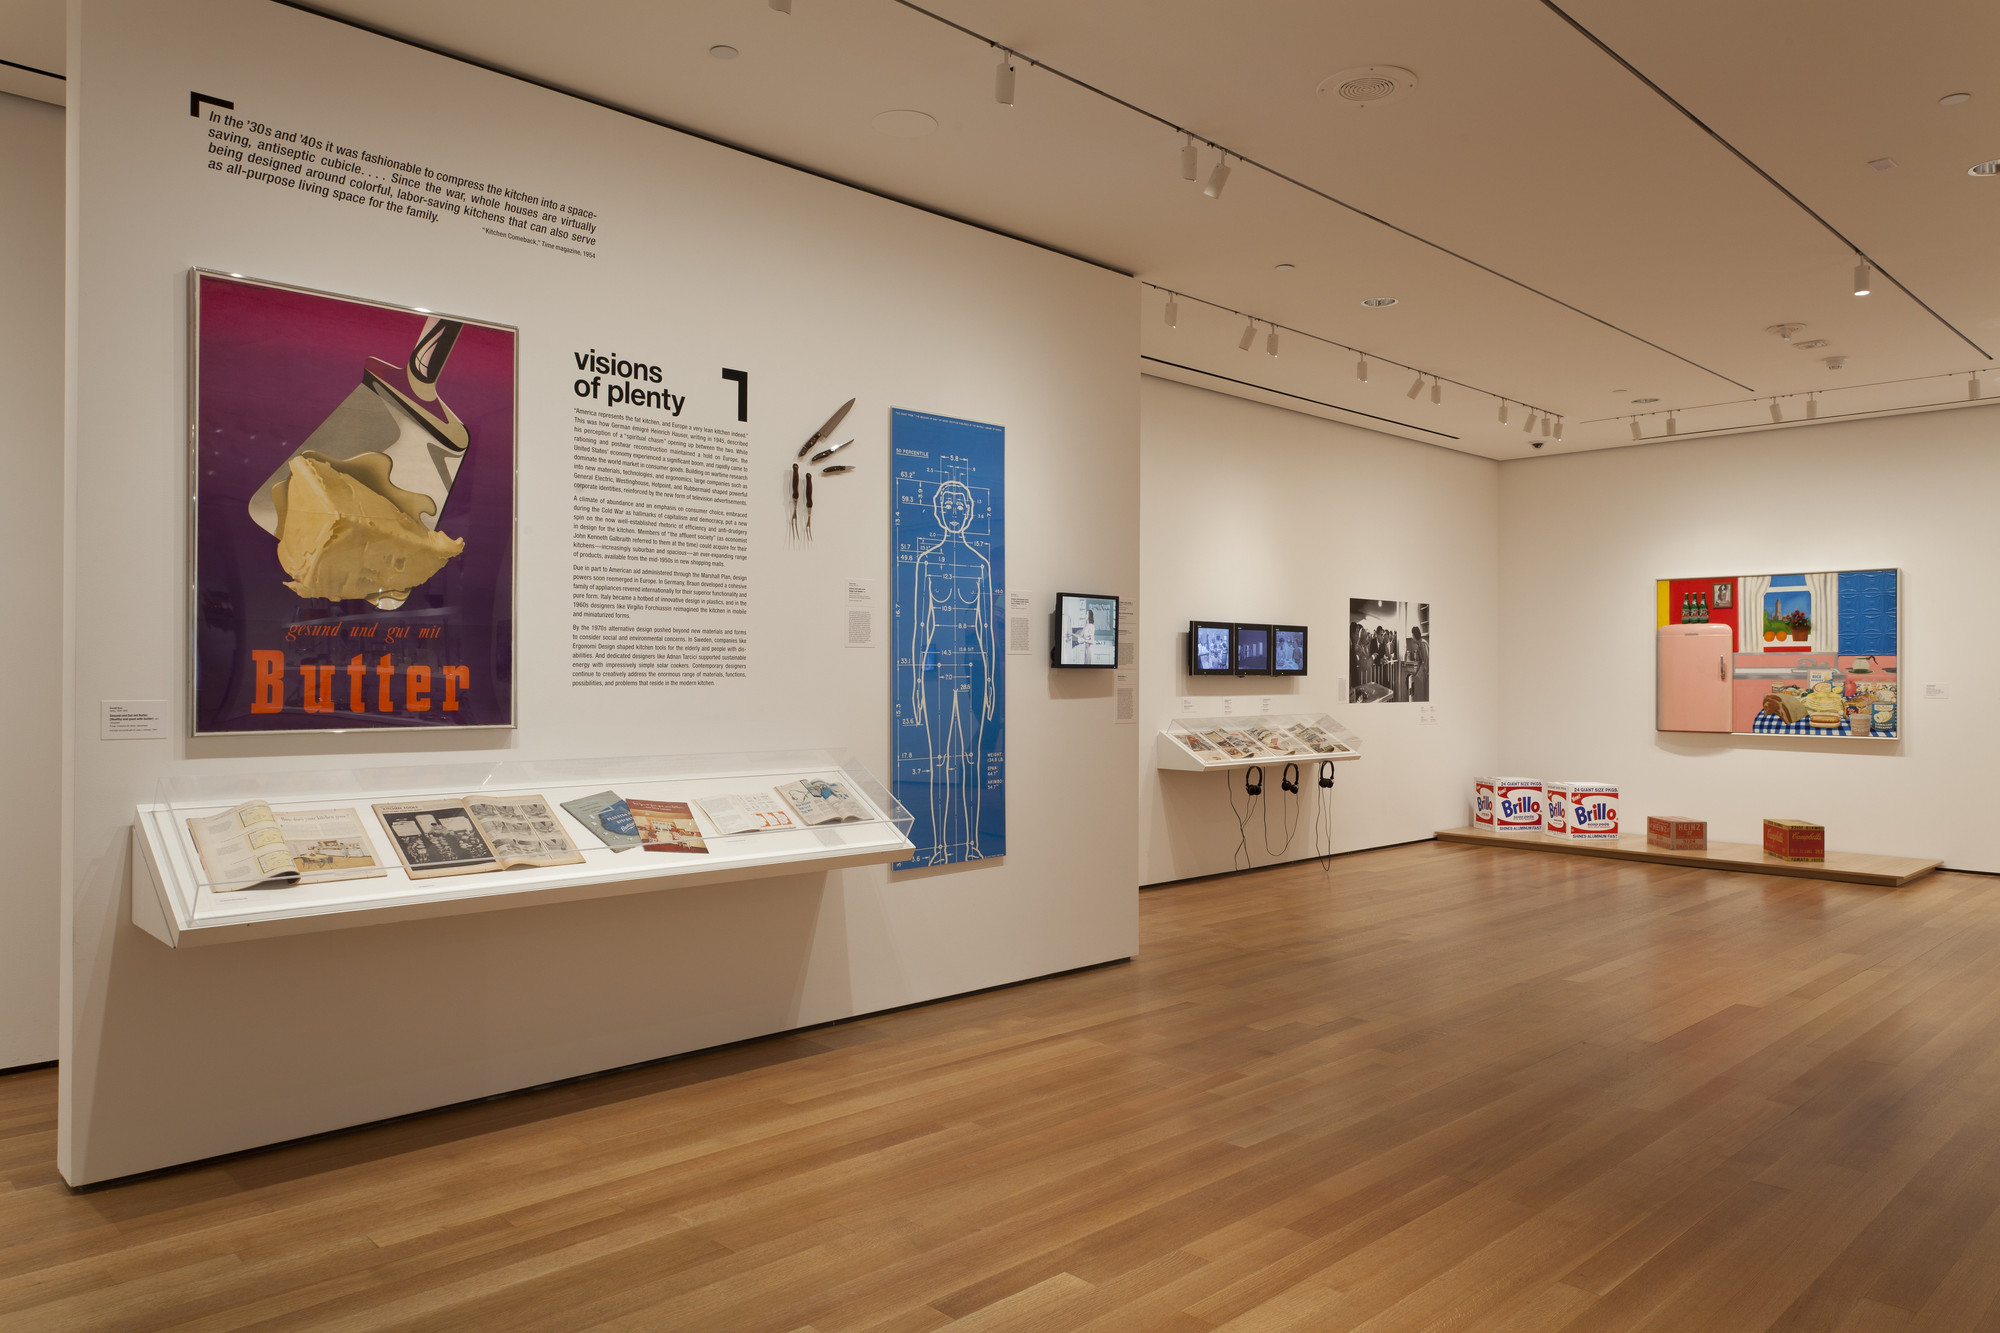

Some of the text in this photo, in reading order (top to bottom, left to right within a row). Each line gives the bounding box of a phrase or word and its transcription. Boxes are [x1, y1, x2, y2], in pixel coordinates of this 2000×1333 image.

[209, 111, 221, 123] In
[224, 115, 244, 129] the
[274, 130, 297, 143] and
[326, 141, 334, 152] it
[337, 146, 358, 158] was
[361, 151, 422, 175] fashionable
[424, 167, 434, 178] to
[436, 173, 484, 191] compress
[487, 184, 502, 196] the
[504, 188, 538, 205] kitchen
[541, 197, 558, 210] into
[567, 206, 597, 219] space-
[208, 129, 251, 148] saving,
[257, 141, 316, 162] antiseptic
[391, 173, 420, 189] Since
[426, 182, 442, 194] the
[446, 189, 465, 202] war,
[472, 195, 500, 209] whole
[504, 201, 538, 218] houses
[542, 213, 557, 223] are
[561, 217, 596, 234] virtually
[208, 160, 438, 223] as all-purpose living space for the family.
[208, 142, 596, 246] being designed around colorful, labor-saving kitchens that can also serve
[542, 241, 555, 249] Time
[555, 245, 582, 256] magazine,
[574, 349, 663, 383] visions
[574, 376, 685, 416] of plenty
[611, 422, 631, 430] German
[285, 622, 442, 644] gesund und gut mit
[250, 649, 470, 714] Butter
[1477, 796, 1492, 811] Brillo
[1501, 797, 1540, 818] Brillo
[1549, 802, 1565, 818] Brillo
[1574, 803, 1616, 825] Brillo
